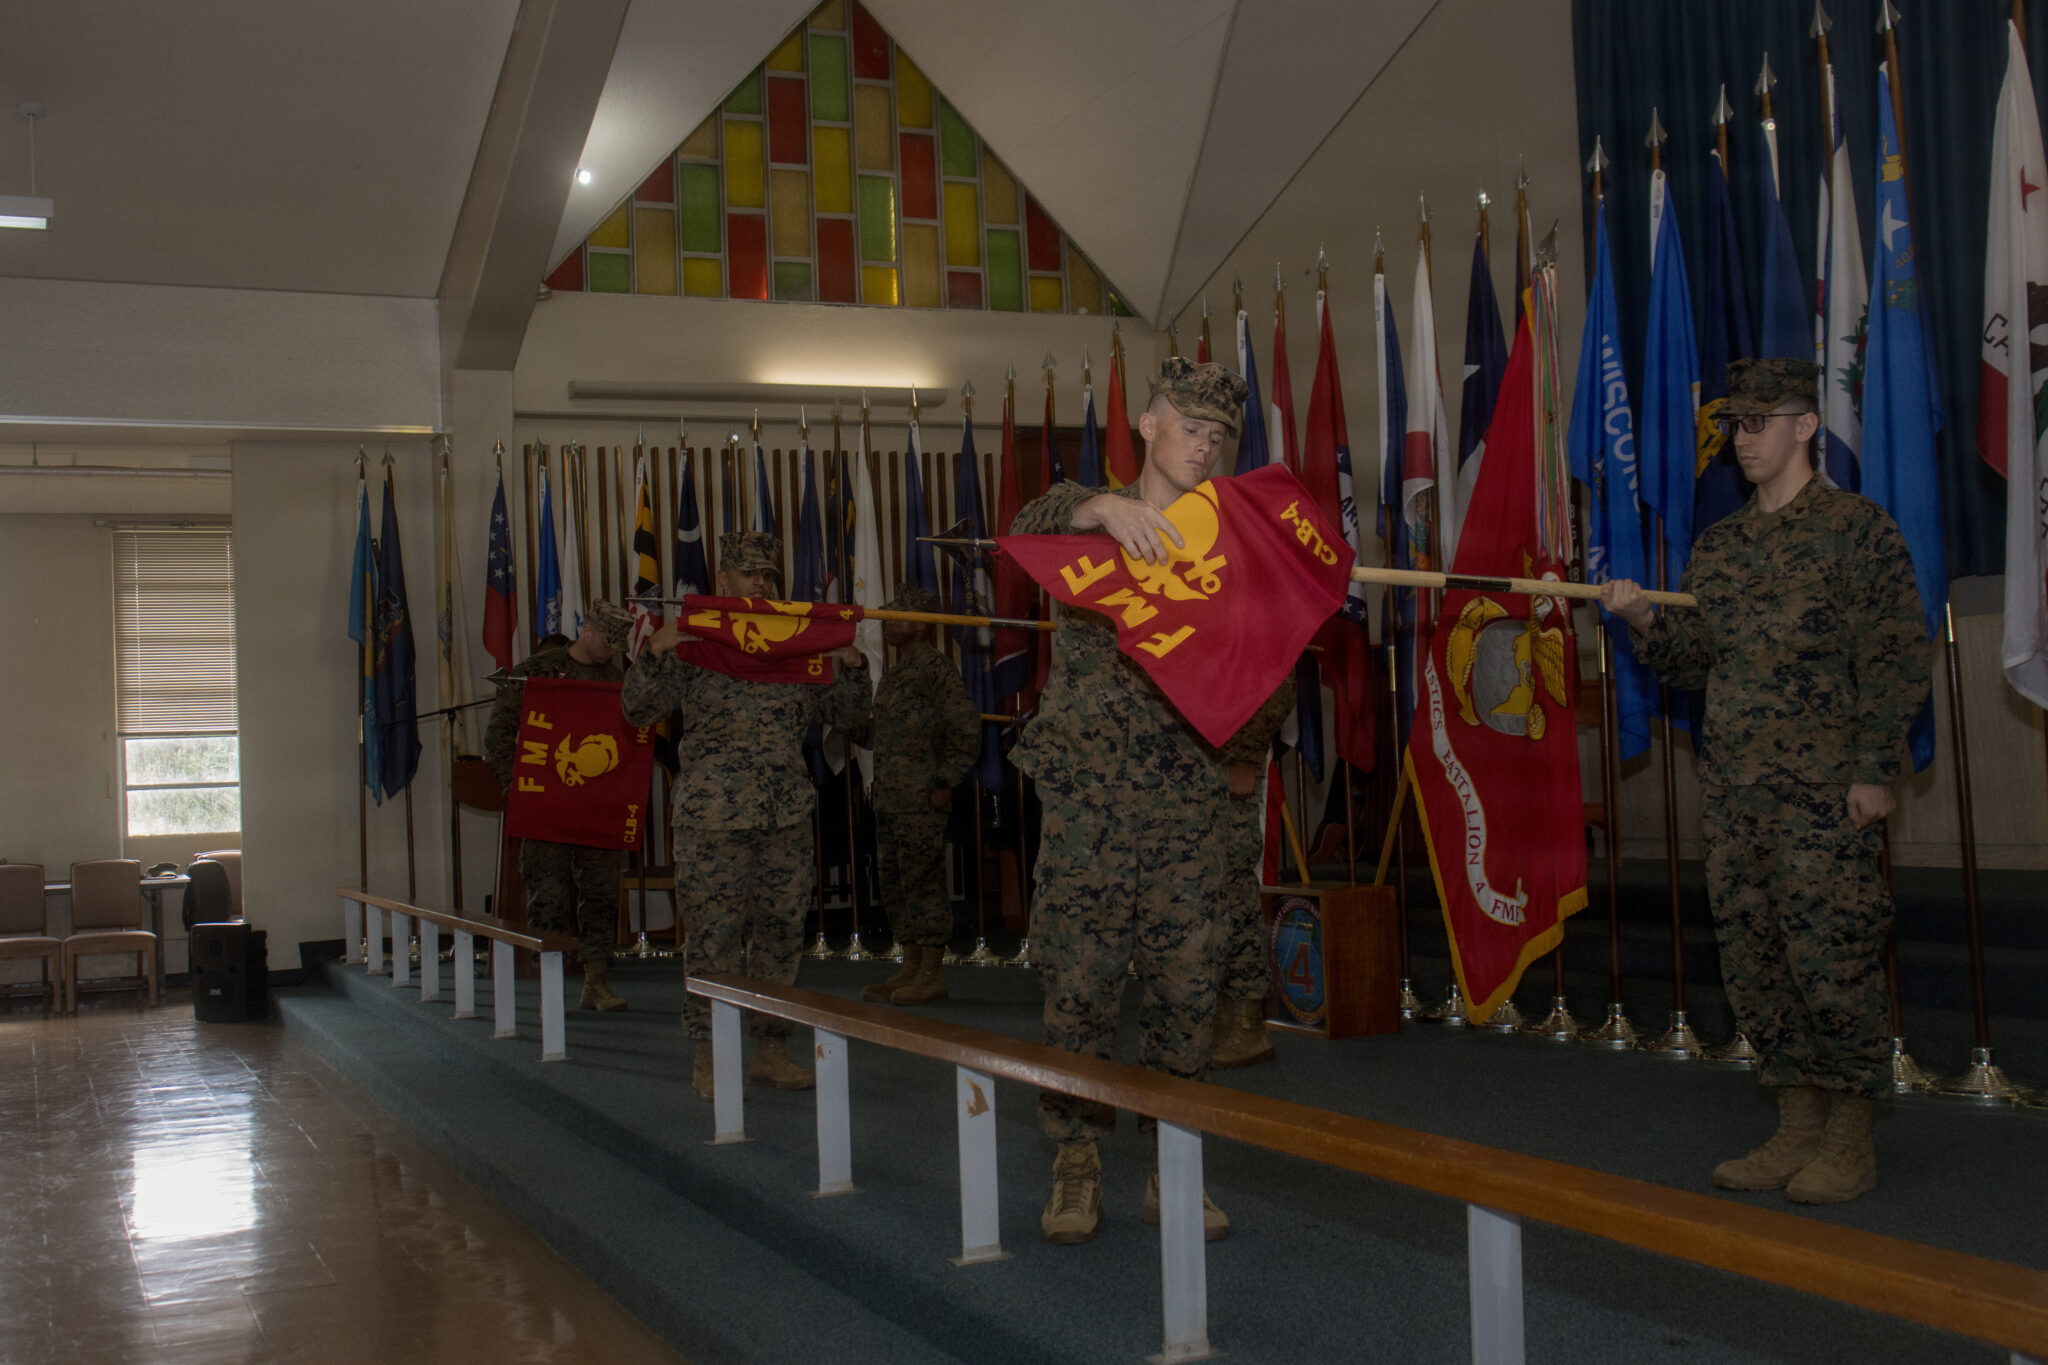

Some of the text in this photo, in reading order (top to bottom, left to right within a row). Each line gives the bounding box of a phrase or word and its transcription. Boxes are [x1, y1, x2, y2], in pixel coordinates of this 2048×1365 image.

[1279, 500, 1339, 566] CLB-4
[623, 803, 640, 844] CLB-4
[1287, 941, 1315, 995] 4
